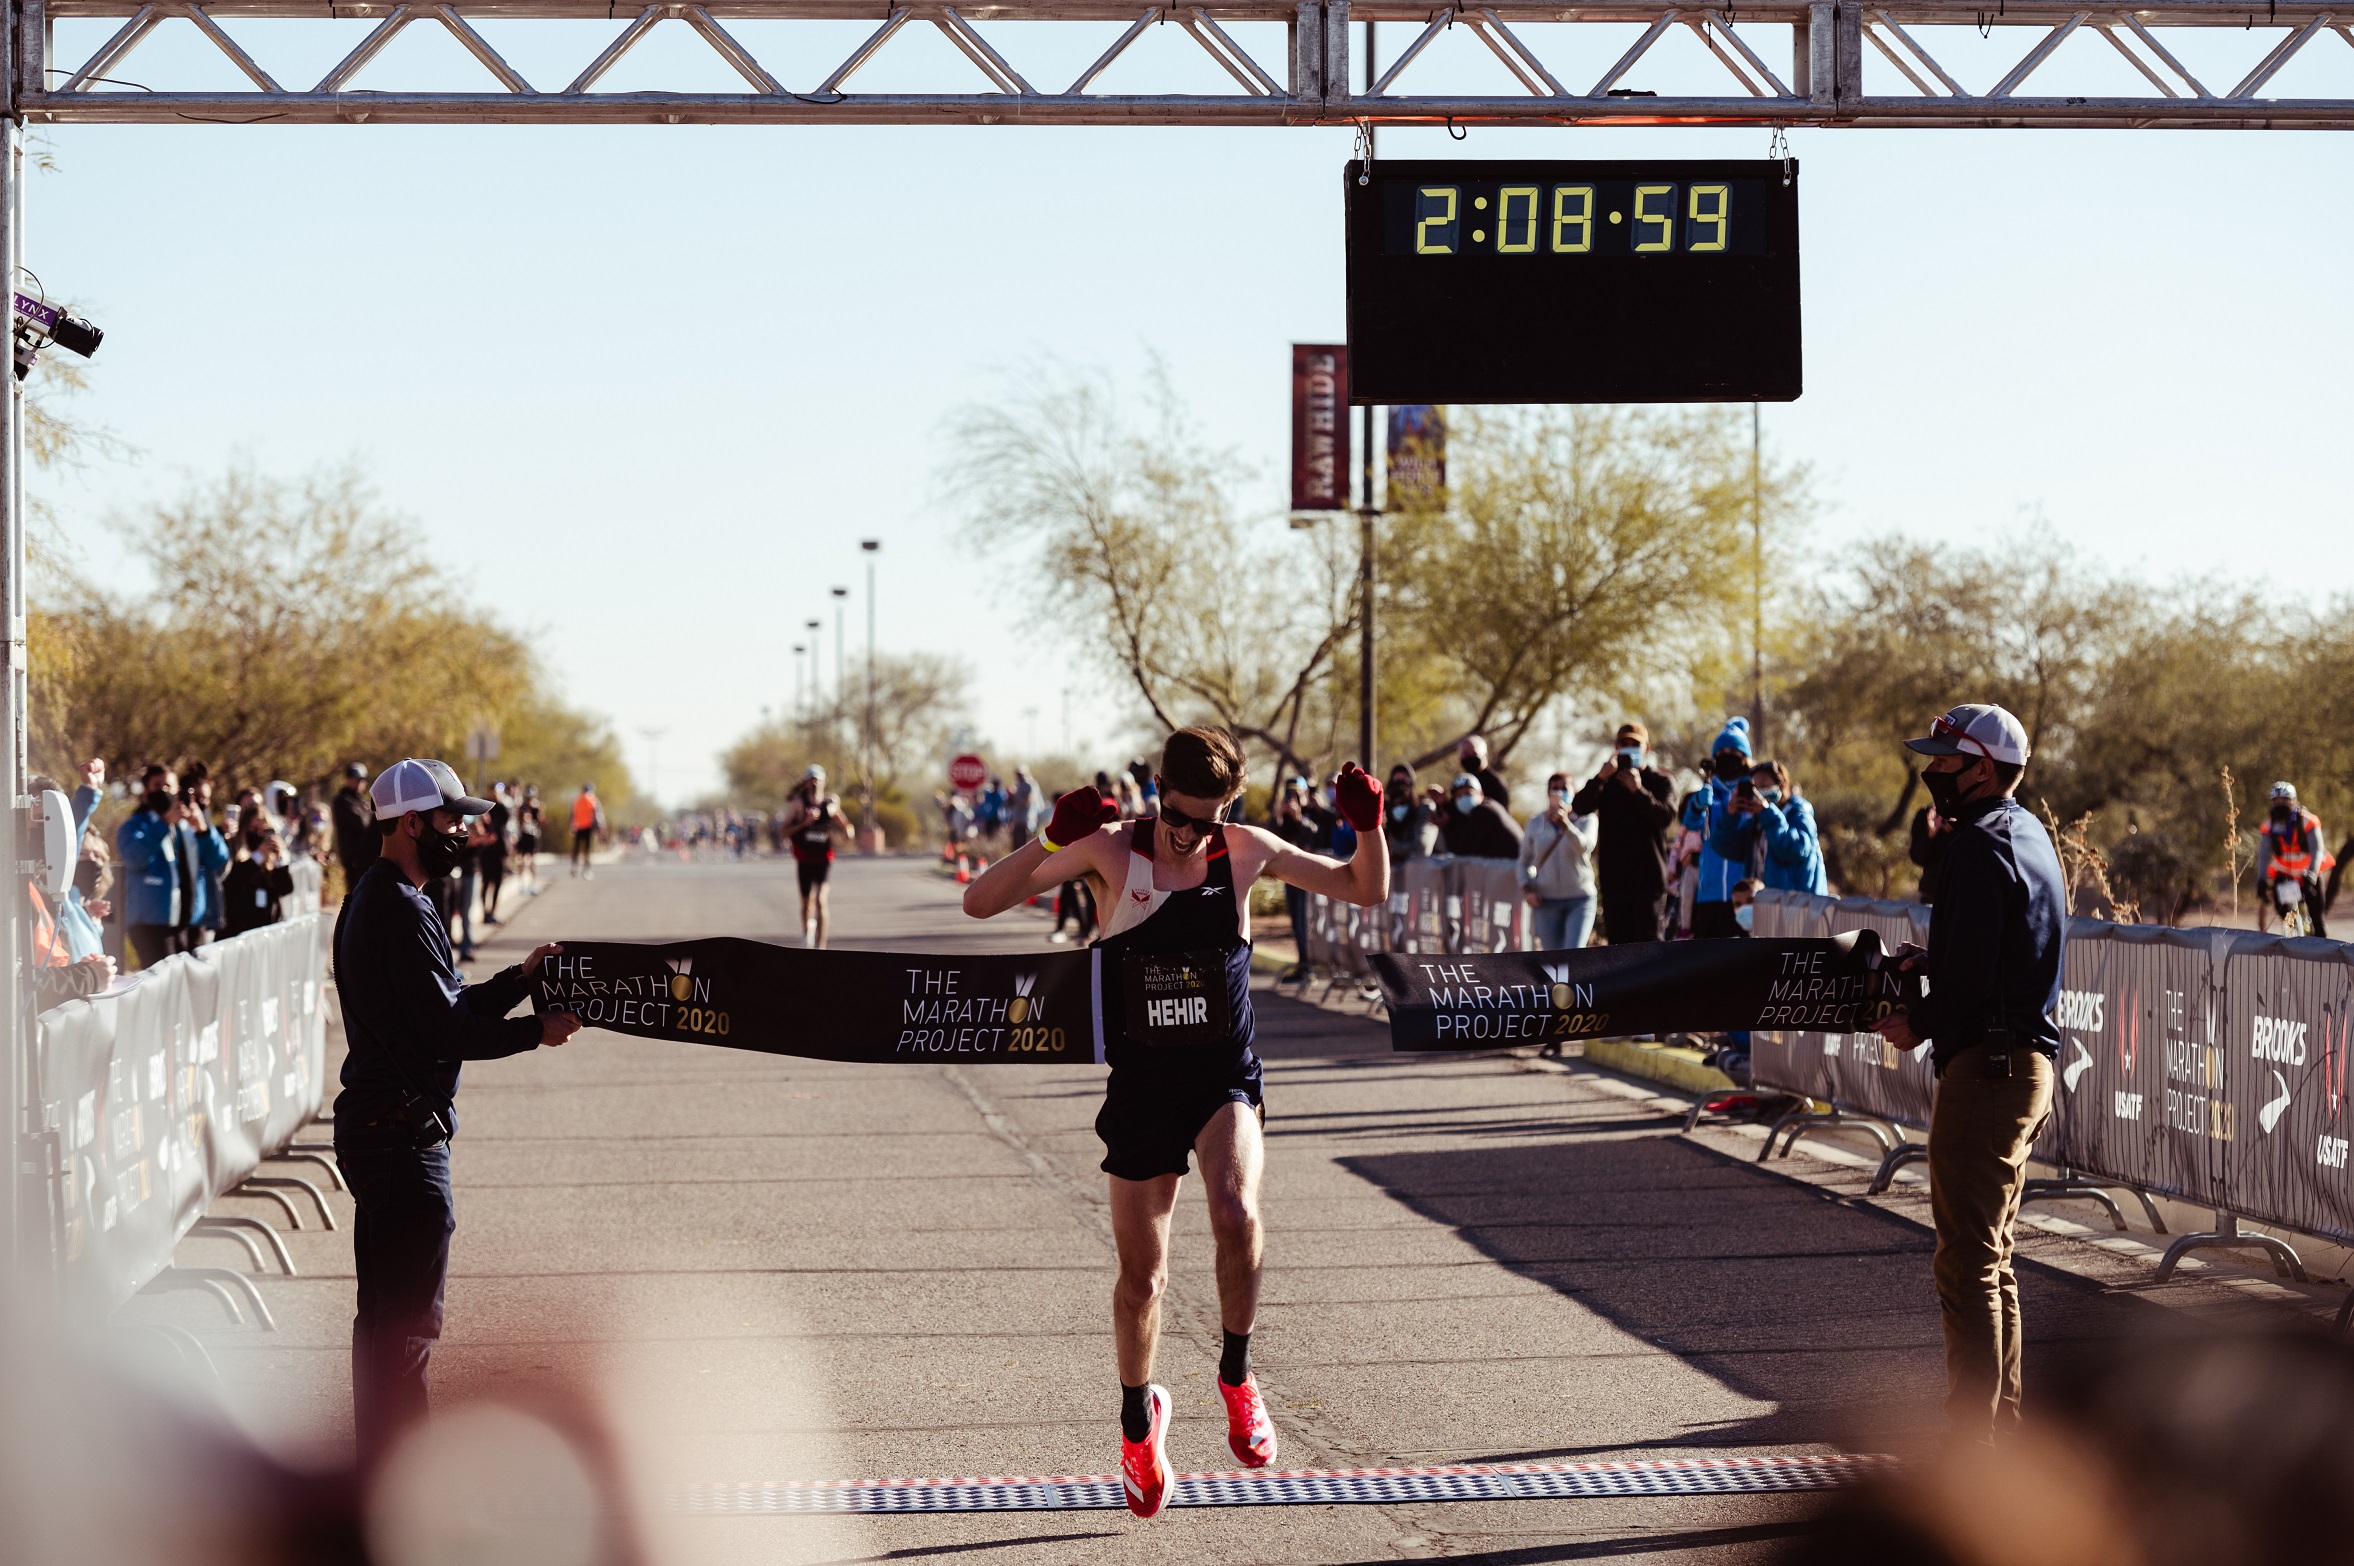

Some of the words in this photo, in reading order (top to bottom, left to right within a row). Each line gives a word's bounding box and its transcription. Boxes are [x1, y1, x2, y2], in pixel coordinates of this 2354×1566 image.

[14, 294, 50, 320] LYNX
[1305, 353, 1335, 499] RAWHIDE
[543, 955, 596, 980] THE
[1145, 966, 1162, 975] THE
[1419, 964, 1480, 984] THE
[1781, 951, 1827, 975] THE
[905, 968, 961, 995] THE
[1145, 981, 1184, 991] PROJECT
[1185, 980, 1206, 989] 2020
[676, 1006, 730, 1036] 2020
[1147, 996, 1208, 1027] HEHIR
[1756, 1003, 1861, 1025] PROJECT
[1860, 1000, 1908, 1022] 20
[2057, 989, 2105, 1033] BROOKS
[2166, 990, 2184, 1032] THE
[896, 1028, 1005, 1052] PROJECT
[1007, 1026, 1066, 1052] 2020
[1436, 1014, 1552, 1040] PROJECT
[1553, 1013, 1610, 1035] 2020
[2252, 1015, 2307, 1066] BROOKS
[2115, 1090, 2143, 1121] USATF
[2167, 1088, 2206, 1136] PROJECT
[2208, 1099, 2235, 1142] 2020
[2316, 1134, 2349, 1169] USATF
